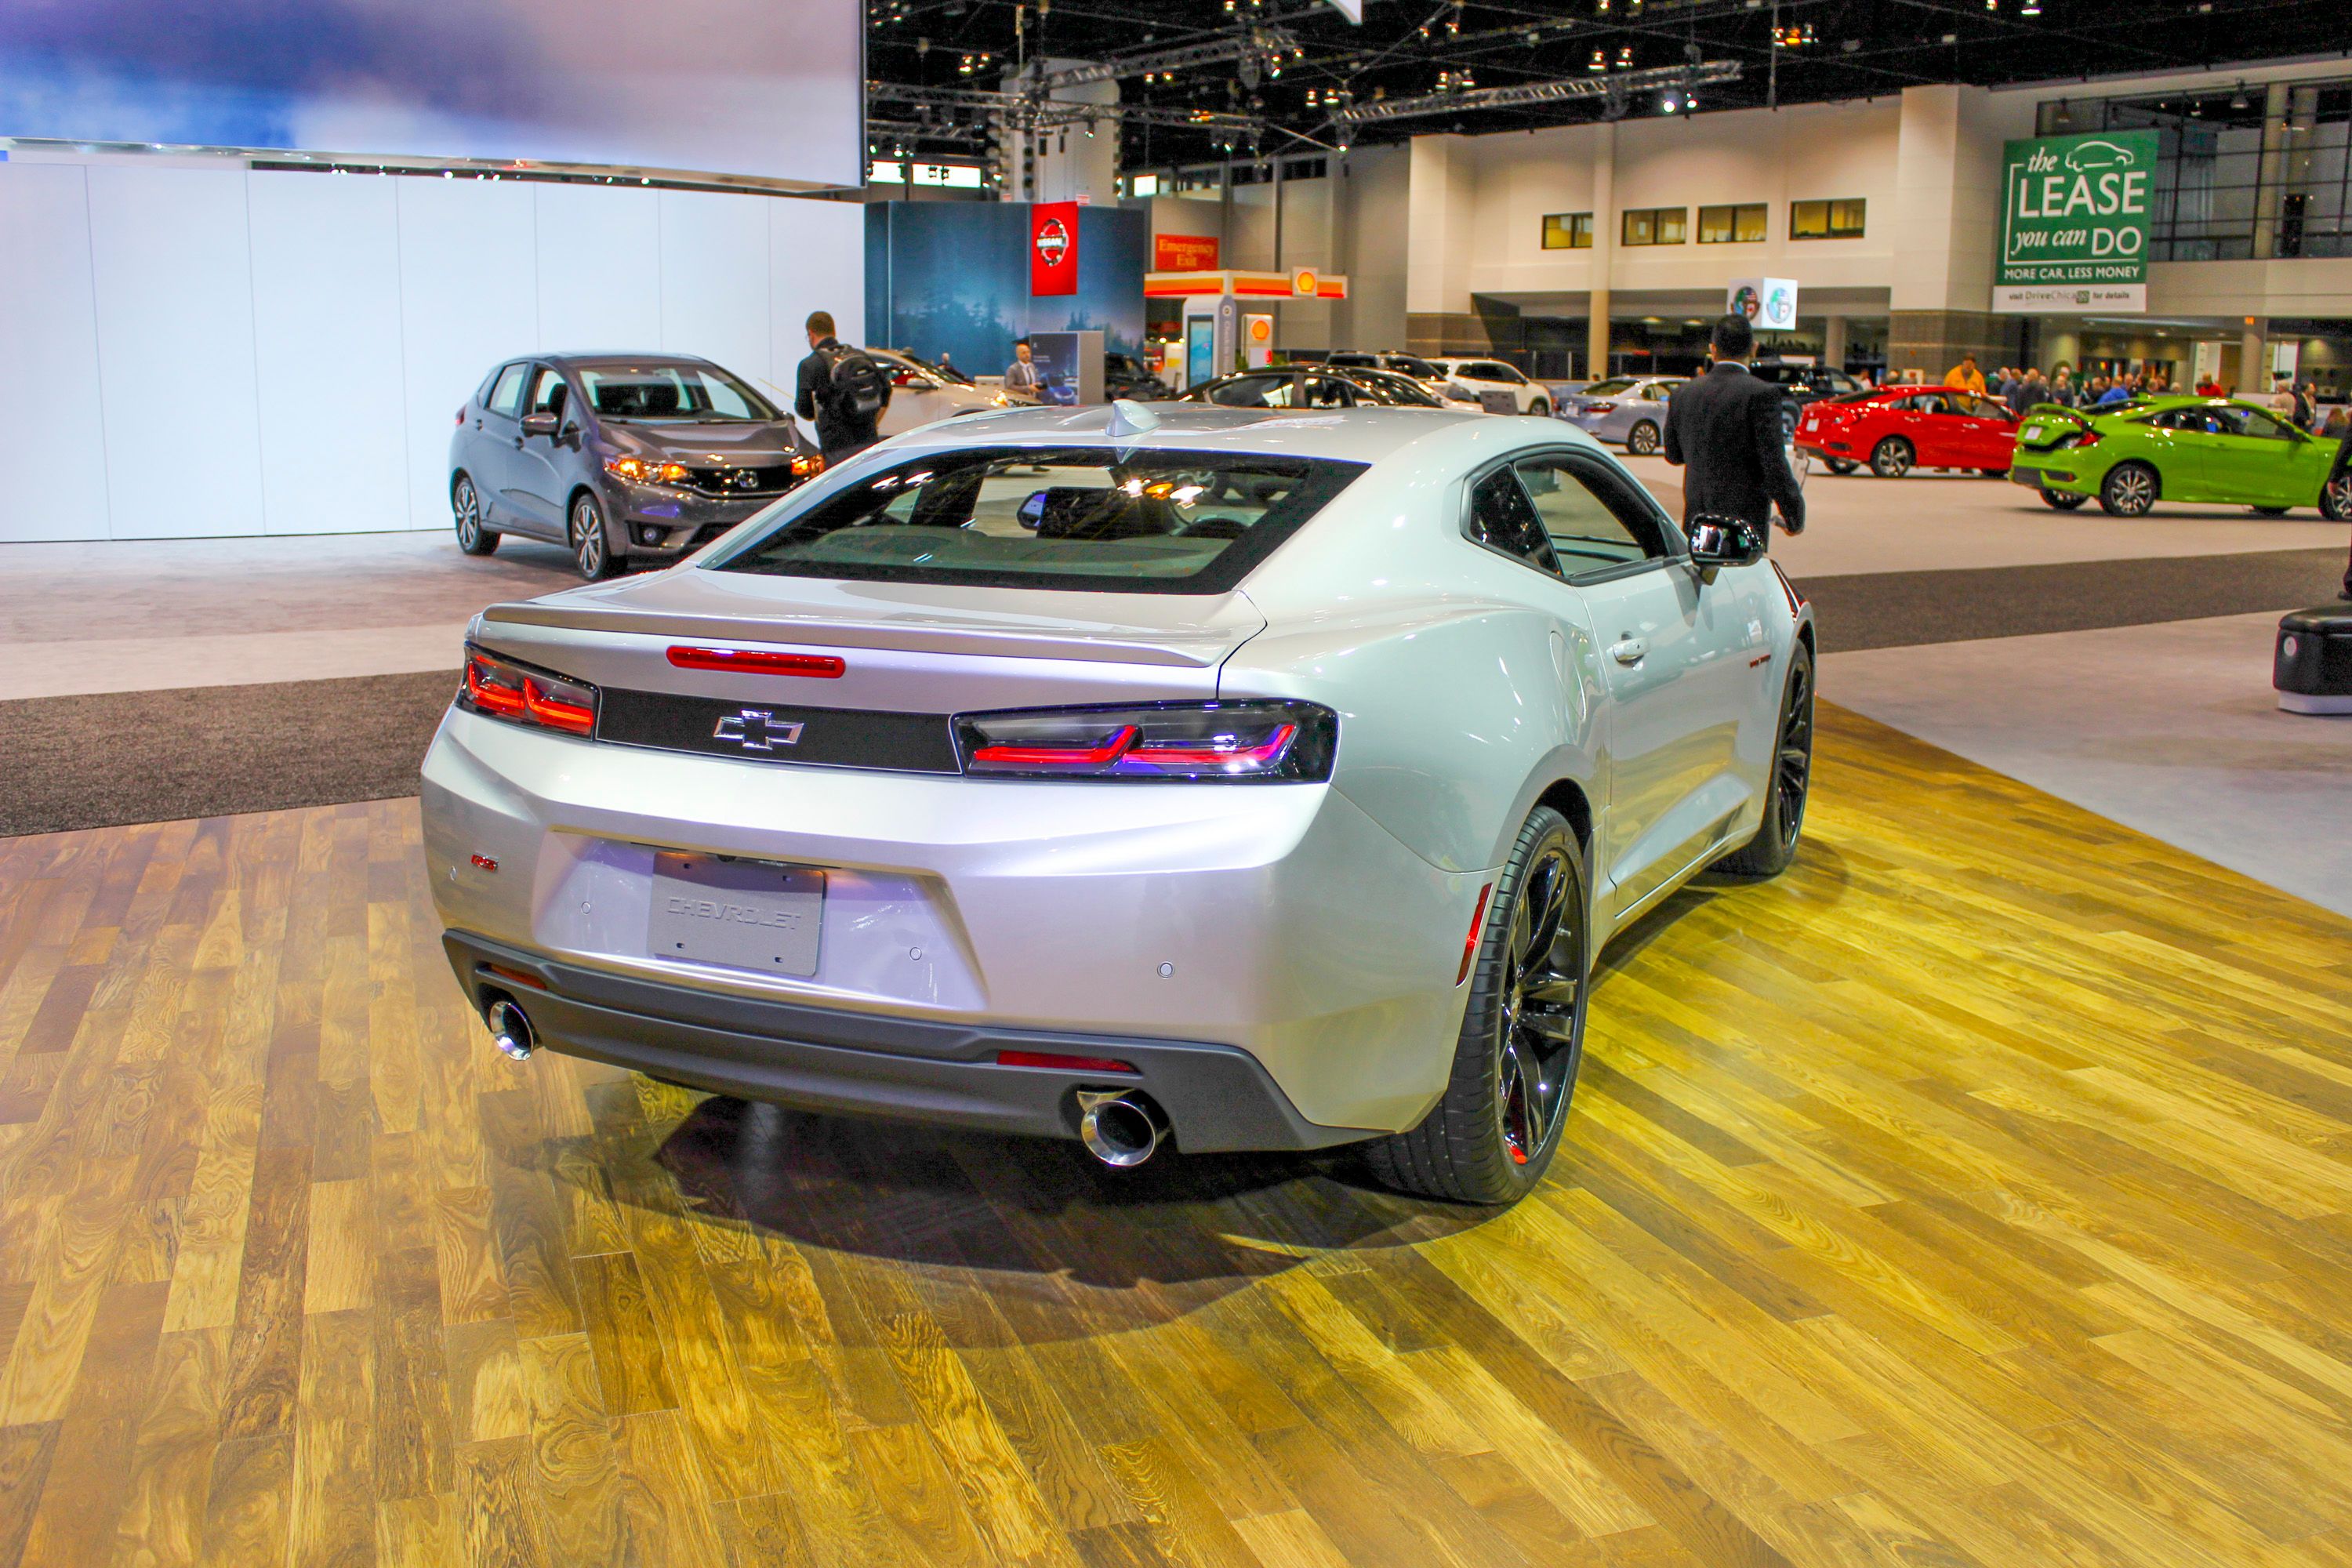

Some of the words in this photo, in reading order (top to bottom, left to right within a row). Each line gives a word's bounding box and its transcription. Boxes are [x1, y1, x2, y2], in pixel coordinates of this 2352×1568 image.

[2027, 146, 2059, 172] the
[2019, 171, 2147, 217] LEASE
[1036, 237, 1063, 247] NISSAN
[1159, 238, 1215, 257] Emergency
[2009, 230, 2049, 256] you
[2052, 229, 2087, 247] can
[2091, 226, 2143, 256] DO
[1176, 253, 1197, 267] Exit
[2004, 268, 2036, 280] MORE
[2039, 267, 2067, 280] CAR,
[2068, 267, 2092, 279] LESS
[2096, 266, 2140, 279] MONEY
[667, 896, 801, 930] CHEVROLET
